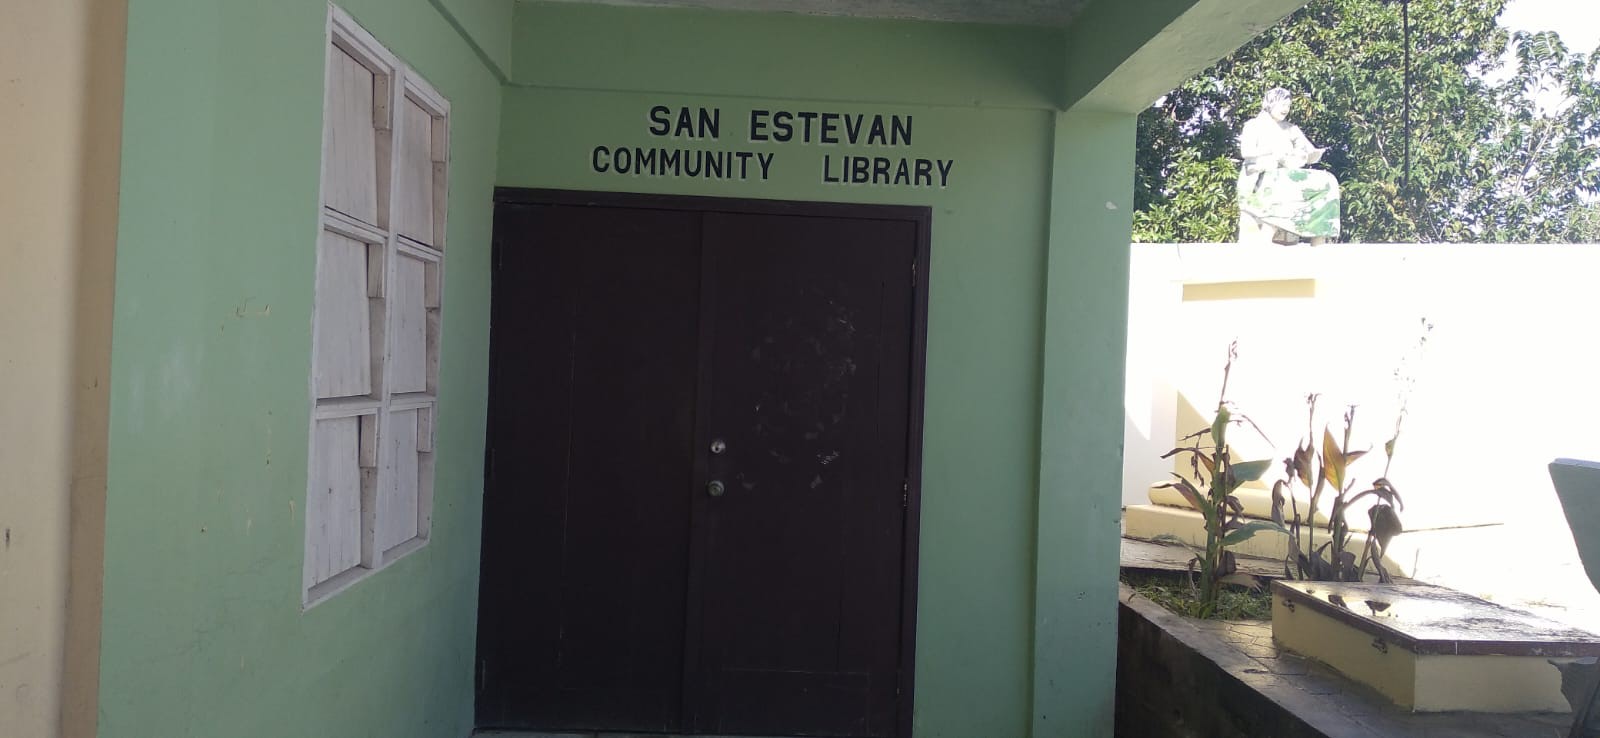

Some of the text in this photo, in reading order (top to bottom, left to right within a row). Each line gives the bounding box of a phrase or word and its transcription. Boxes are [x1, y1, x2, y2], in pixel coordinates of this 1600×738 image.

[649, 105, 914, 146] SAN ESTEVAN
[592, 145, 955, 188] COMMUNITY LIBRARY
